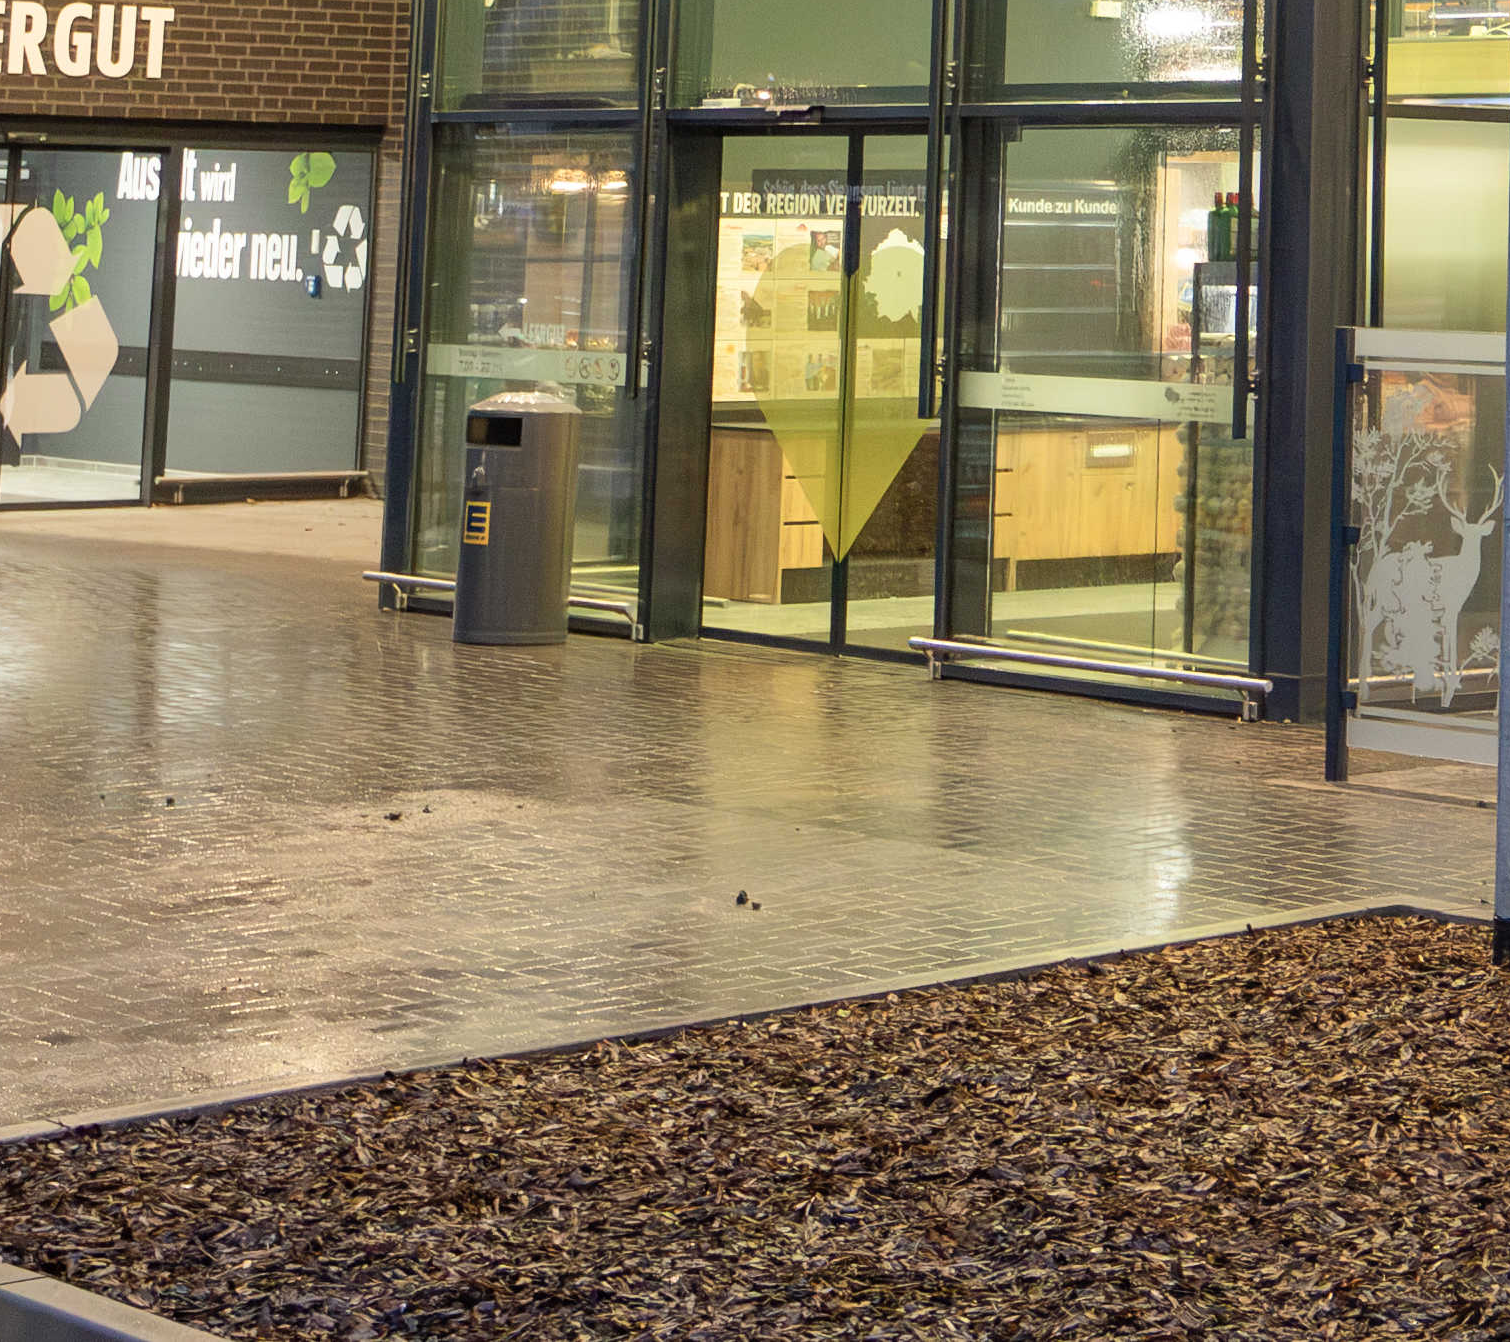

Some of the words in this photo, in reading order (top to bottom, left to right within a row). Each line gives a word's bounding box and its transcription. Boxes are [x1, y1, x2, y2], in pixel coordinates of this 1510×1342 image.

[116, 151, 162, 201] Aus
[200, 162, 237, 202] wird
[733, 192, 762, 214] DER
[766, 193, 821, 215] REGION
[825, 194, 920, 217] VEURZELT.
[1008, 198, 1053, 214] Kunde
[1055, 202, 1072, 214] zu
[1075, 198, 1118, 215] Kunde
[250, 232, 304, 282] neu.
